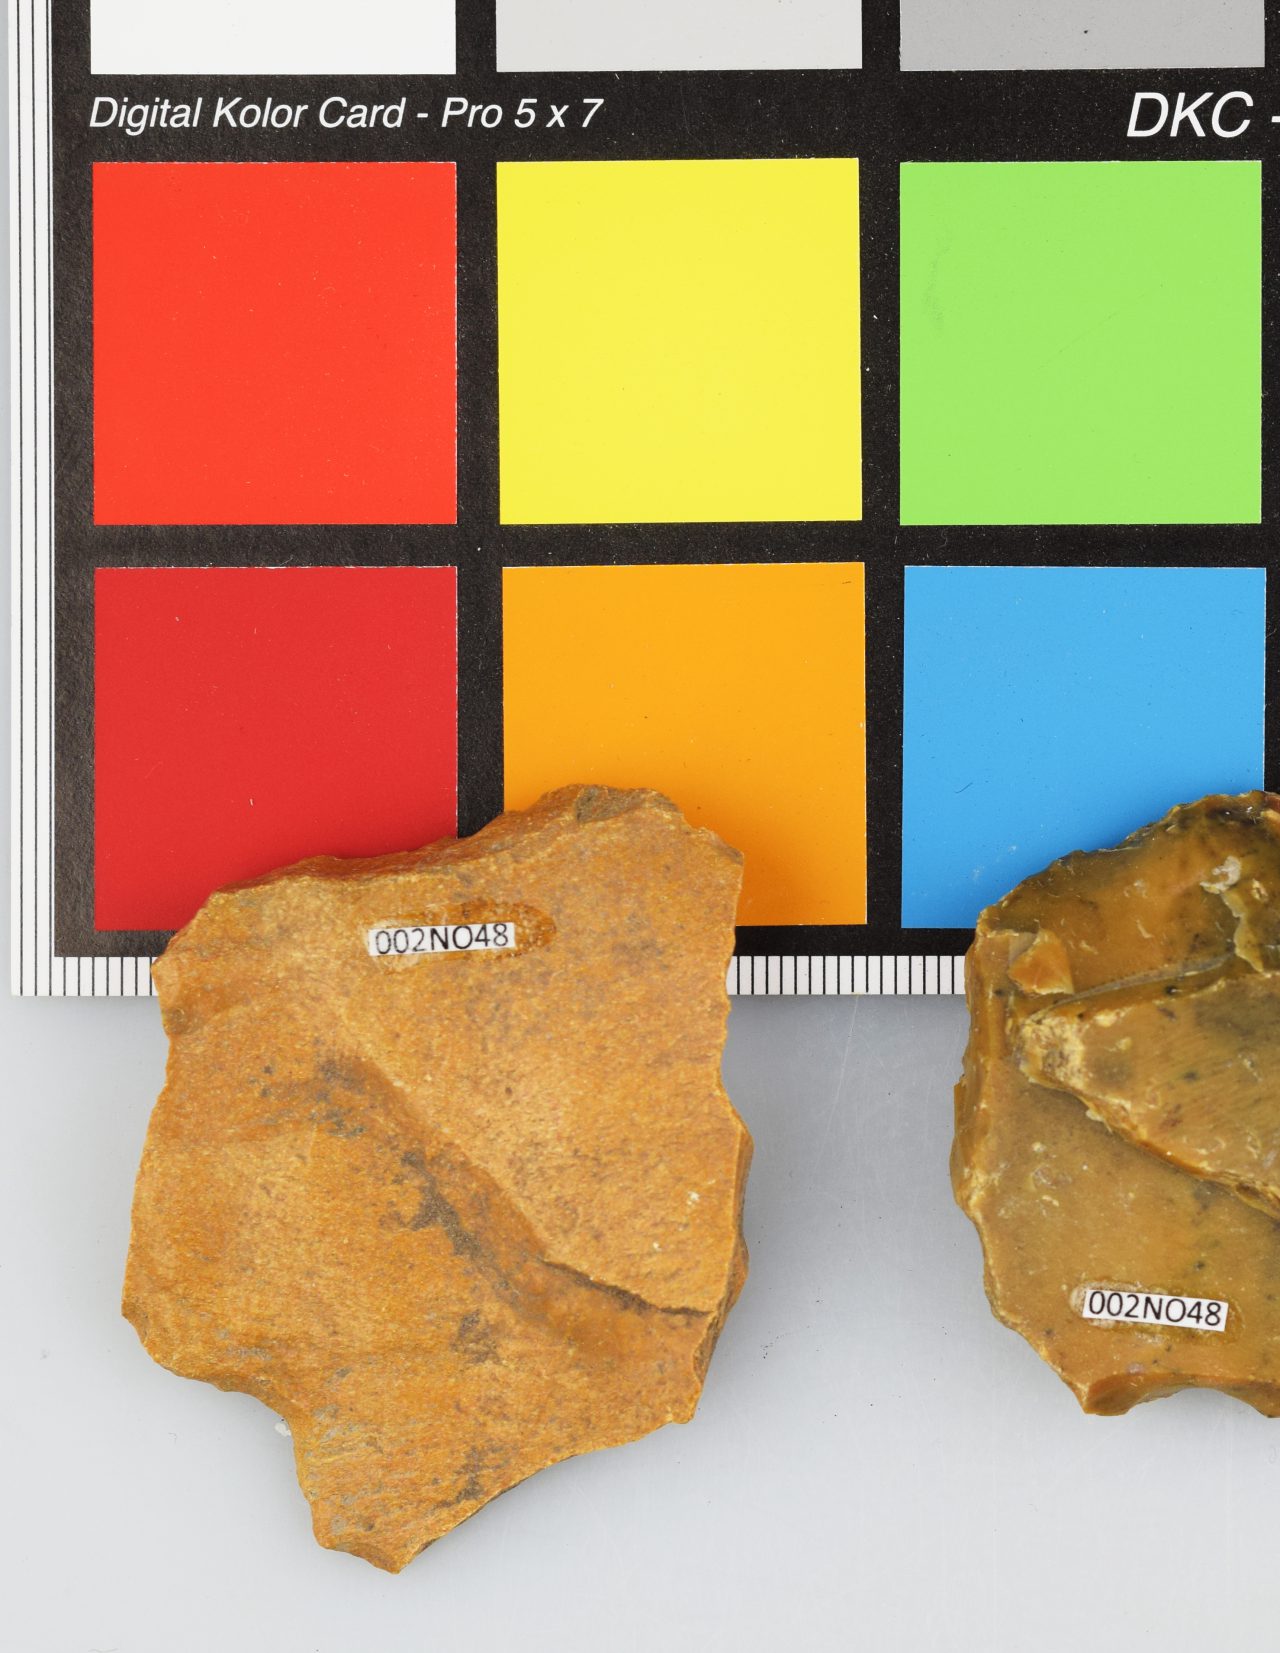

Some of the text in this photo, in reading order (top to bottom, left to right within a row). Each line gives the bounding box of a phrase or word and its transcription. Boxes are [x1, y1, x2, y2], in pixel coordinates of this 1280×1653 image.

[89, 96, 203, 137] Digital
[212, 96, 309, 129] Kolor
[318, 96, 407, 129] Card
[441, 96, 503, 129] Pro
[514, 98, 538, 129] 5
[545, 104, 570, 128] x
[581, 98, 605, 128] 7
[1126, 90, 1254, 139] DKC
[375, 922, 509, 954] 002NO48
[1089, 1290, 1222, 1327] 002NO48
